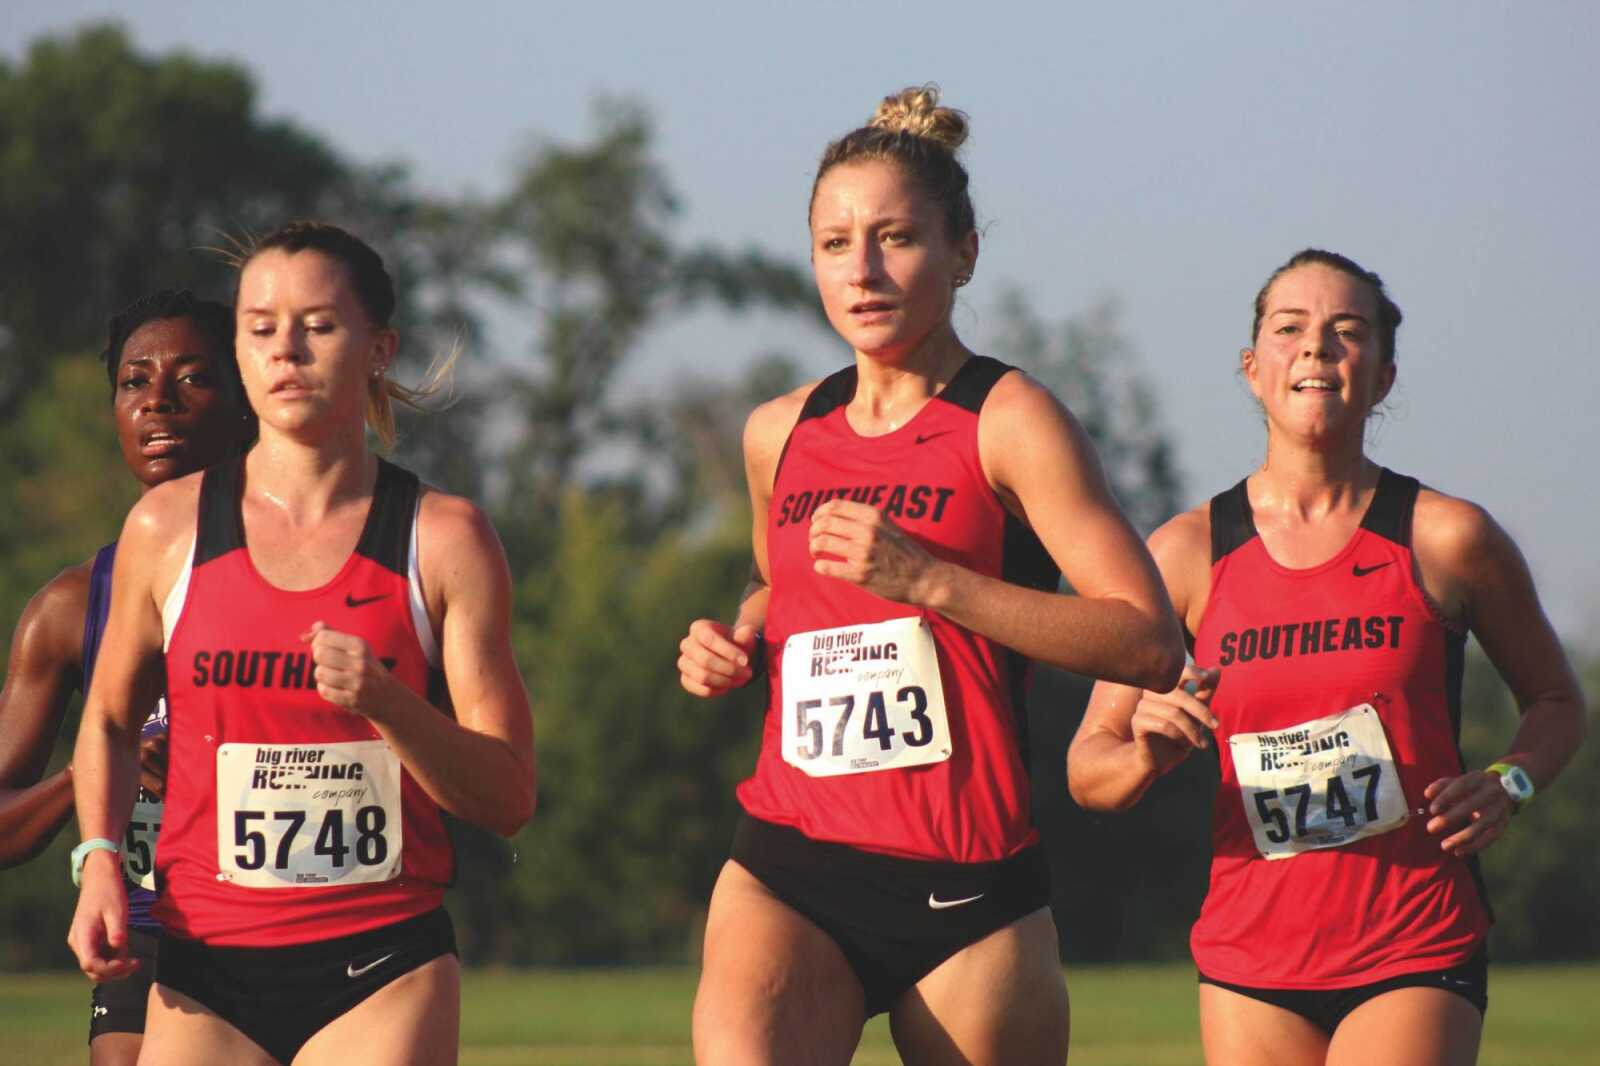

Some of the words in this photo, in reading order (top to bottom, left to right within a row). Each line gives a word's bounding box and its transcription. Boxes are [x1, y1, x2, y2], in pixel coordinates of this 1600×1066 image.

[813, 635, 833, 651] big
[836, 631, 864, 647] river
[1219, 616, 1405, 667] SOUTHEAST
[192, 650, 397, 690] SOUTH
[857, 667, 905, 688] company
[796, 685, 934, 760] 5743
[1257, 733, 1279, 747] big
[1278, 729, 1310, 744] river
[255, 748, 281, 765] big
[285, 750, 325, 763] river
[312, 787, 368, 806] company
[1253, 763, 1382, 843] 5747
[234, 805, 388, 870] 5748
